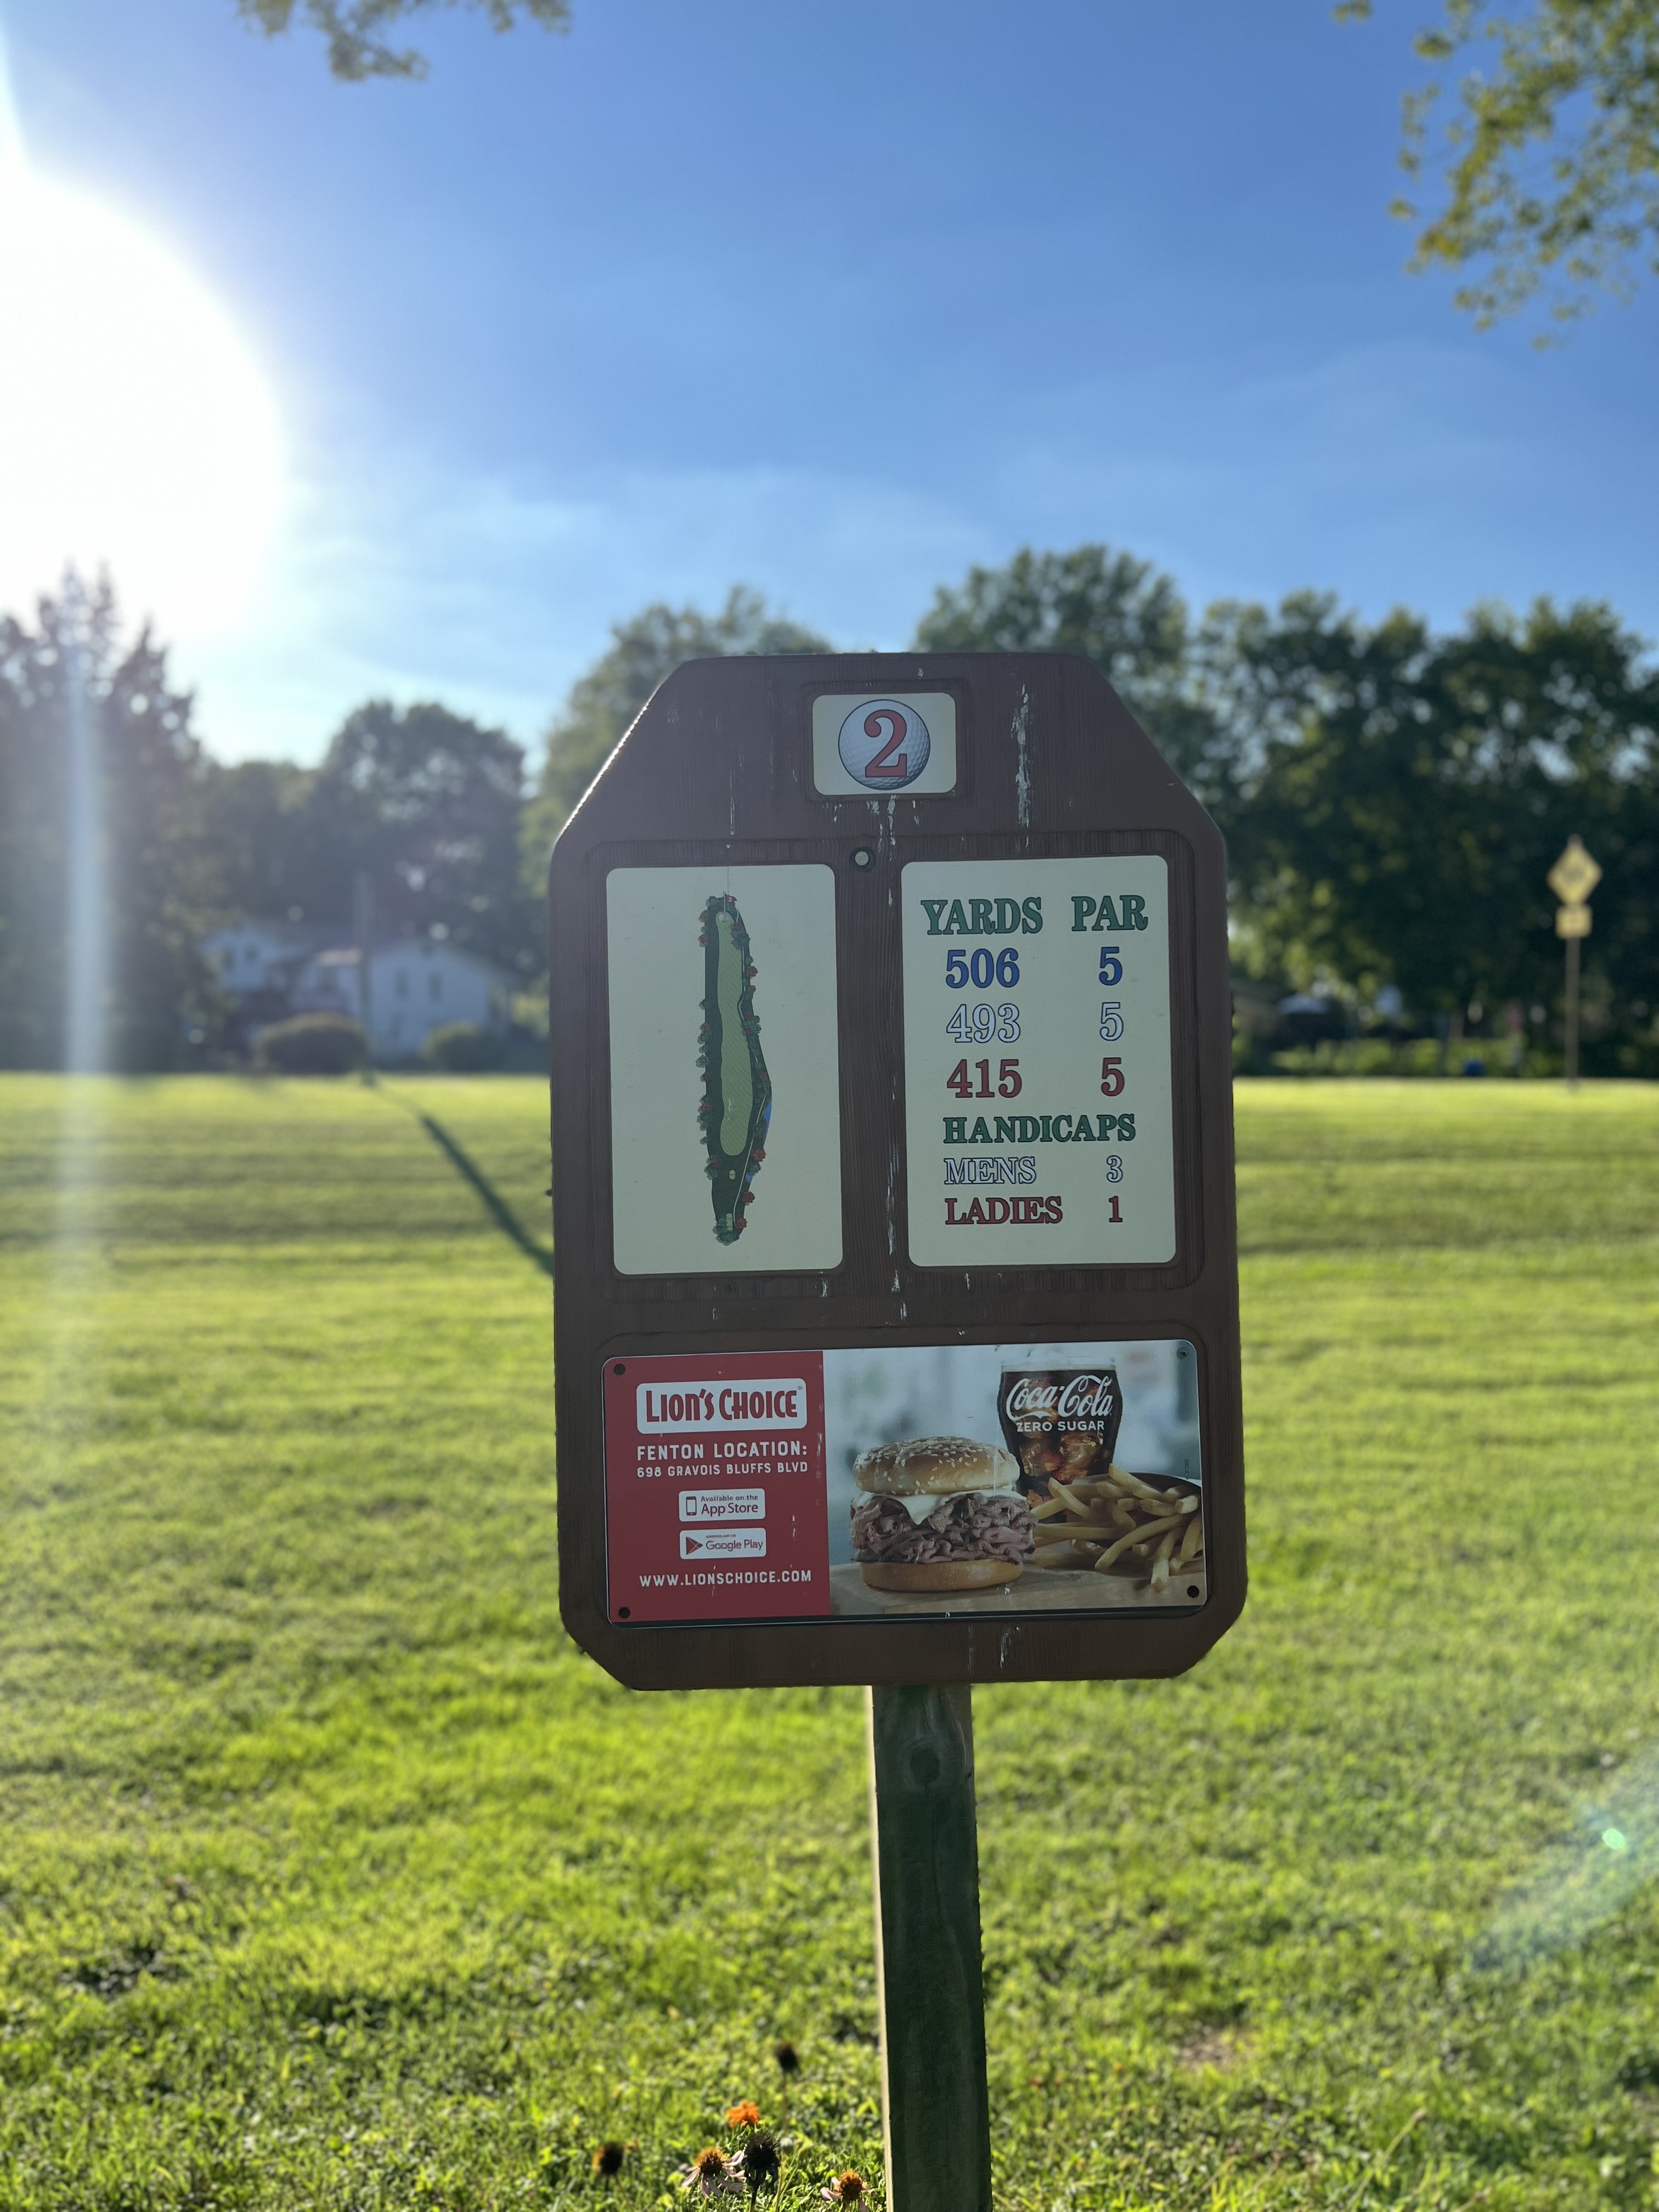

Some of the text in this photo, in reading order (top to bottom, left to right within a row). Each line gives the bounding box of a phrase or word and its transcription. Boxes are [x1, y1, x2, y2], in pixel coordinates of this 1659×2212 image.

[864, 709, 907, 778] 2
[921, 895, 1148, 935] YARDS PAR
[945, 947, 1123, 988] 506 5
[946, 1002, 1124, 1043] 493 5
[946, 1058, 1125, 1098] 415 5
[943, 1114, 1136, 1144] HANDICAPS
[944, 1155, 1124, 1184] MENS 3
[945, 1196, 1124, 1224] LADIES 1
[719, 1389, 797, 1420] CHOICE
[1006, 1375, 1113, 1421] Coca-Cola
[1017, 1420, 1105, 1432] ZERO SUGAR
[637, 1441, 808, 1460] FENTON LOCATION:
[637, 1462, 808, 1477] 698 GRAVOIS BLUFFS BLVD
[701, 1503, 759, 1517] App Store
[706, 1539, 764, 1552] Google Play
[639, 1570, 811, 1587] WWW.LIONSCHOICE.COM
